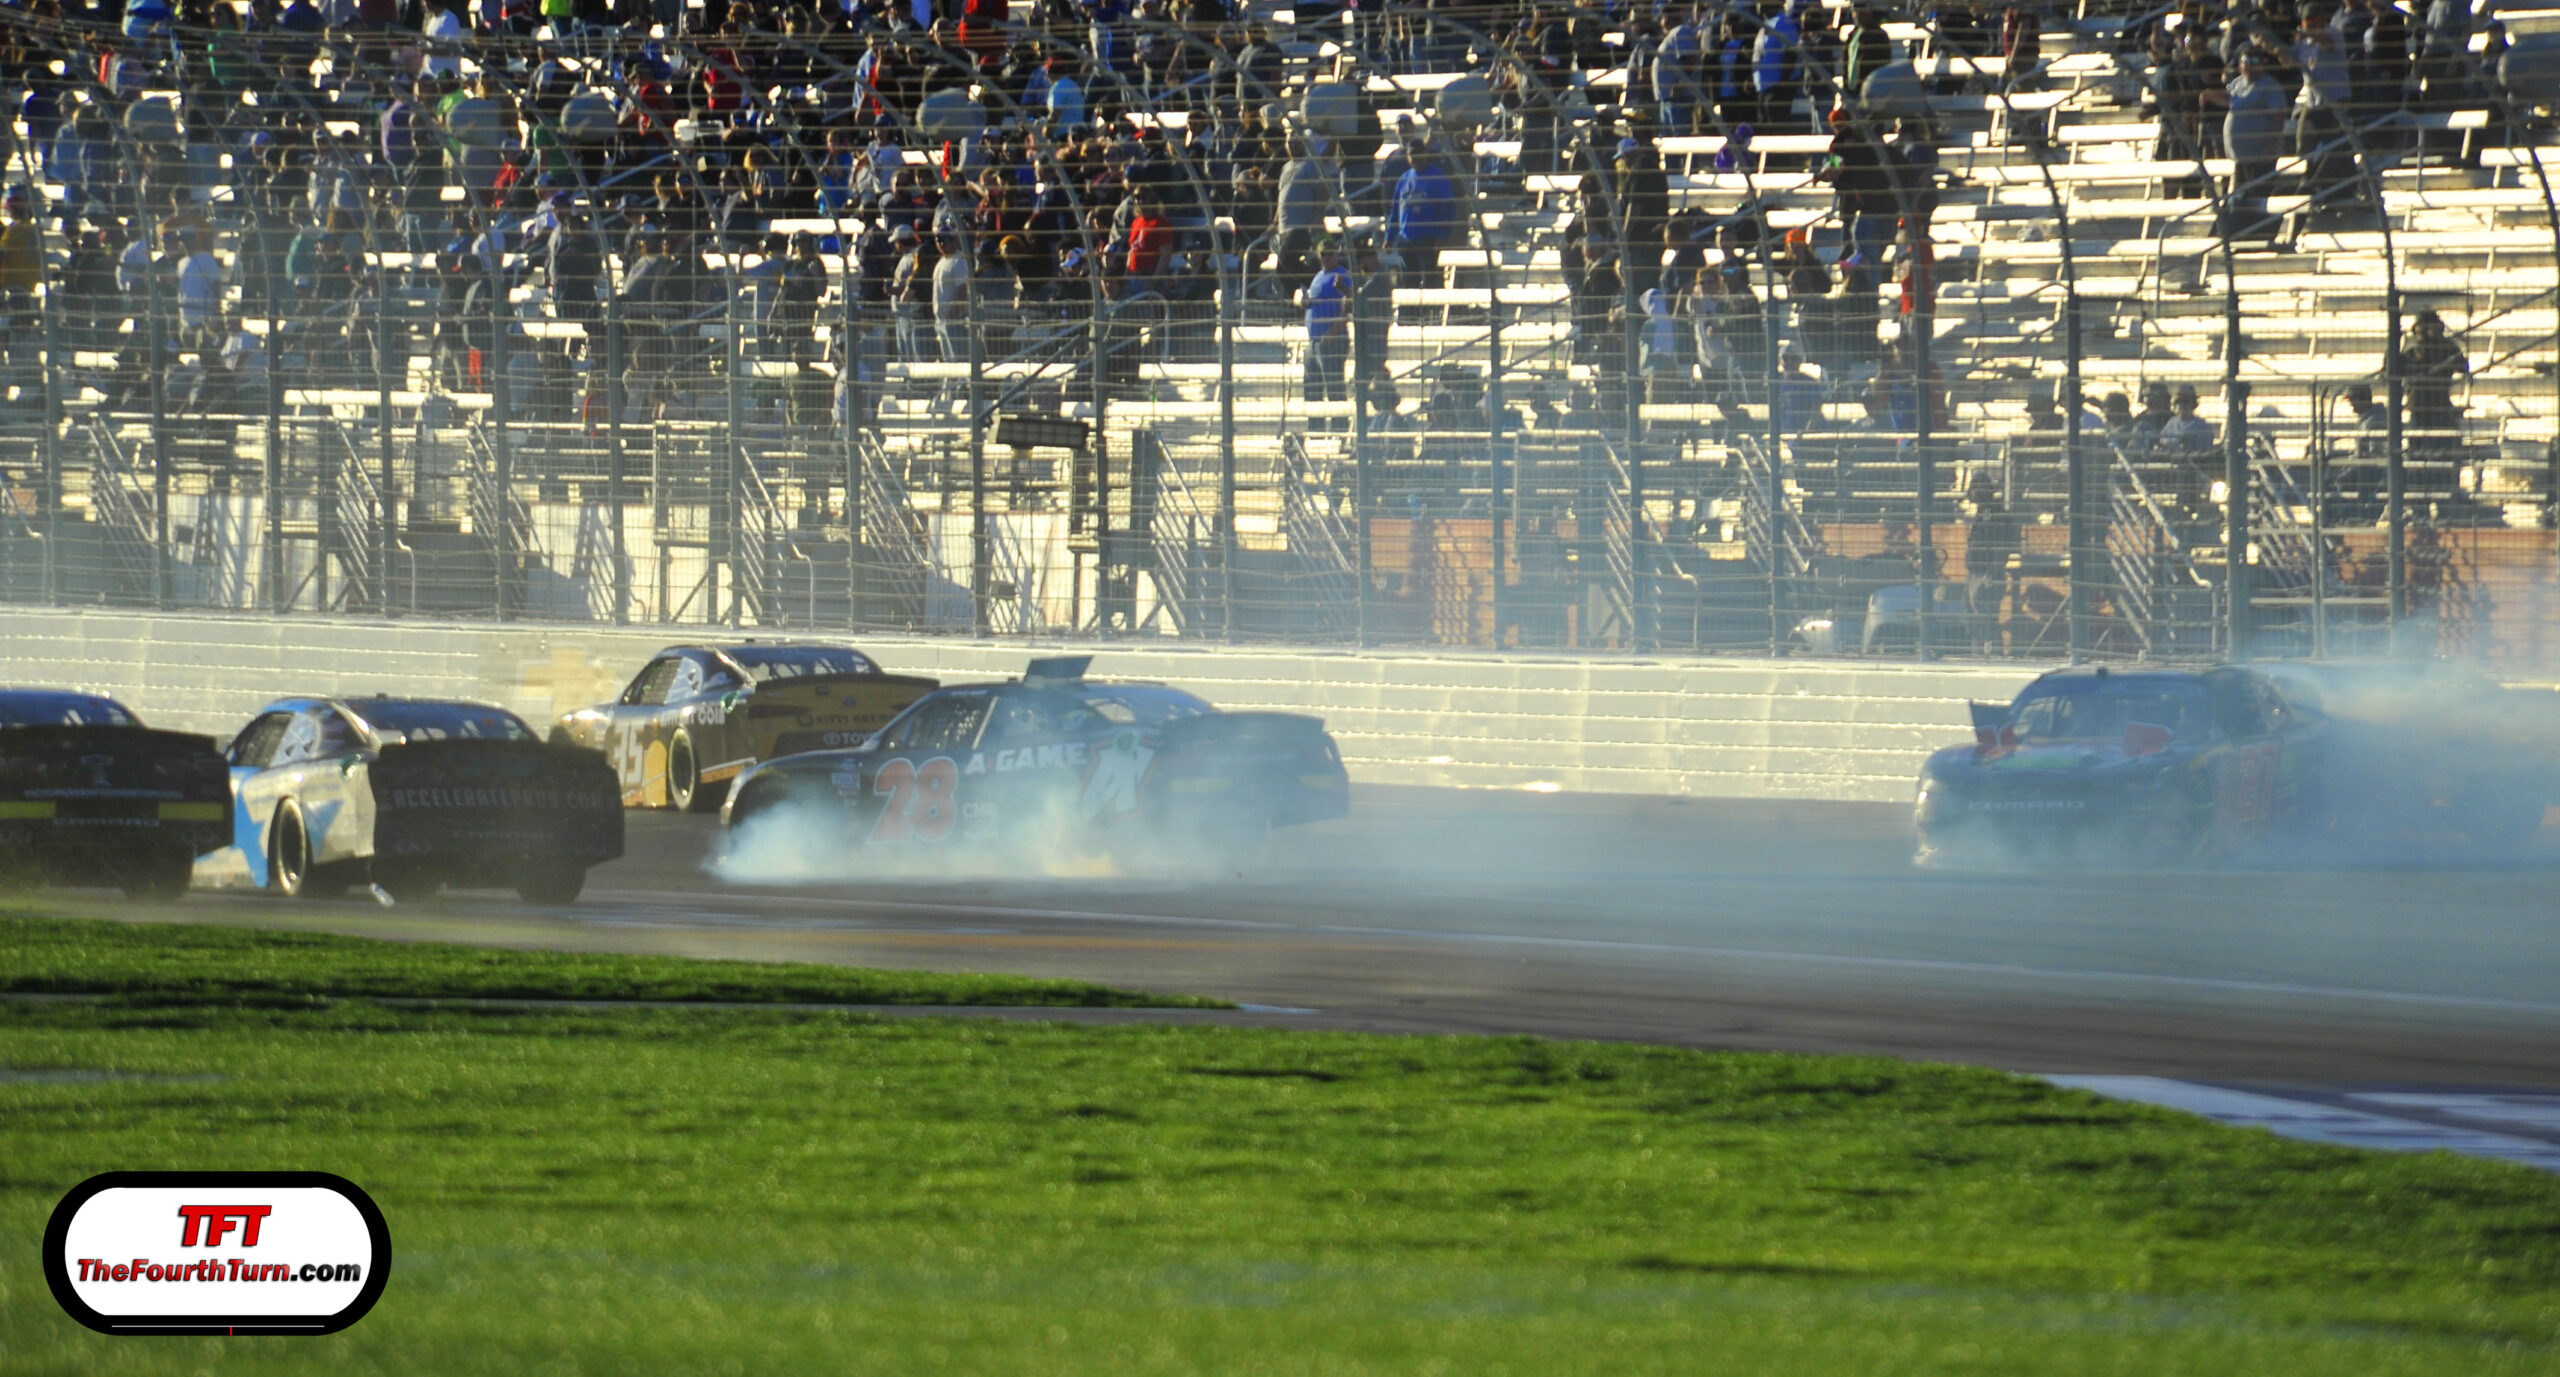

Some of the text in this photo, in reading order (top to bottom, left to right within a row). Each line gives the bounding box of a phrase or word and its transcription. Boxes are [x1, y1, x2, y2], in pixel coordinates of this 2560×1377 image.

[613, 718, 646, 785] 35
[841, 732, 870, 744] TOY
[965, 742, 1088, 775] A GAME
[867, 756, 958, 843] 28
[1966, 799, 2086, 810] CAMARO
